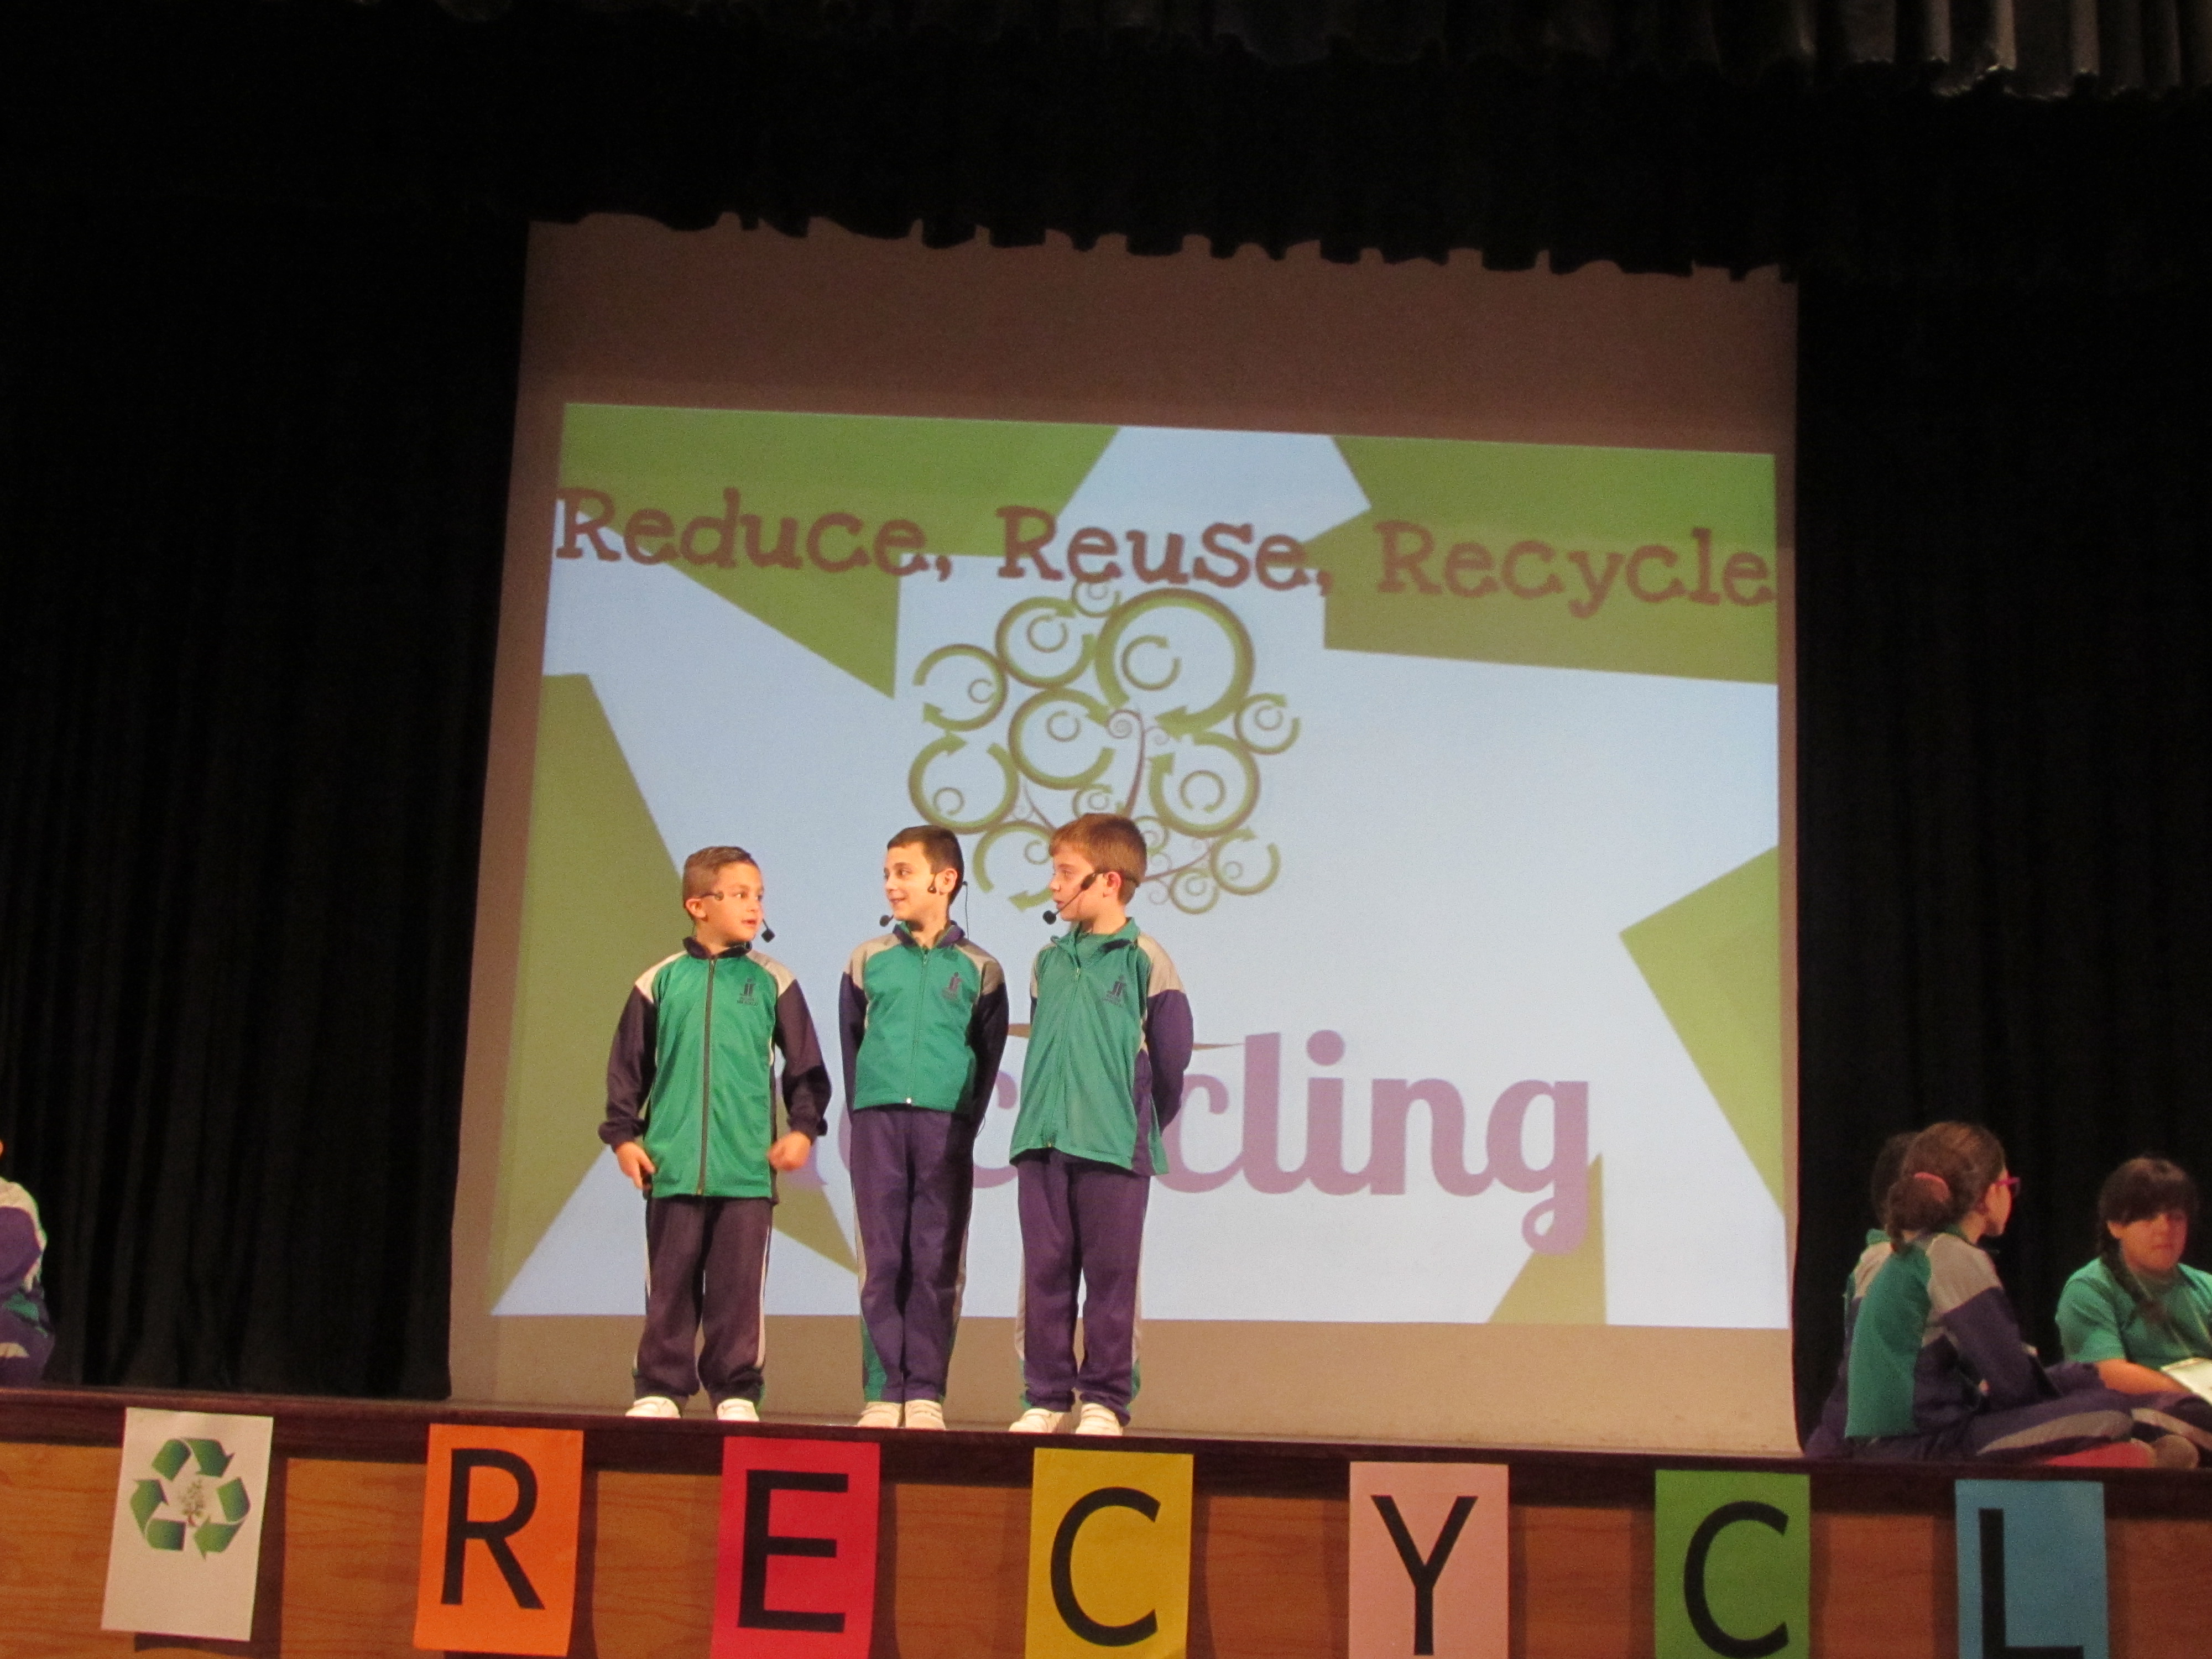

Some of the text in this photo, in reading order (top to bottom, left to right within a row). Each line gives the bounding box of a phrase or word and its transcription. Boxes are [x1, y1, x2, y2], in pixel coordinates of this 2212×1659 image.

[555, 487, 1777, 619] Reduce, Reuse, Recycle
